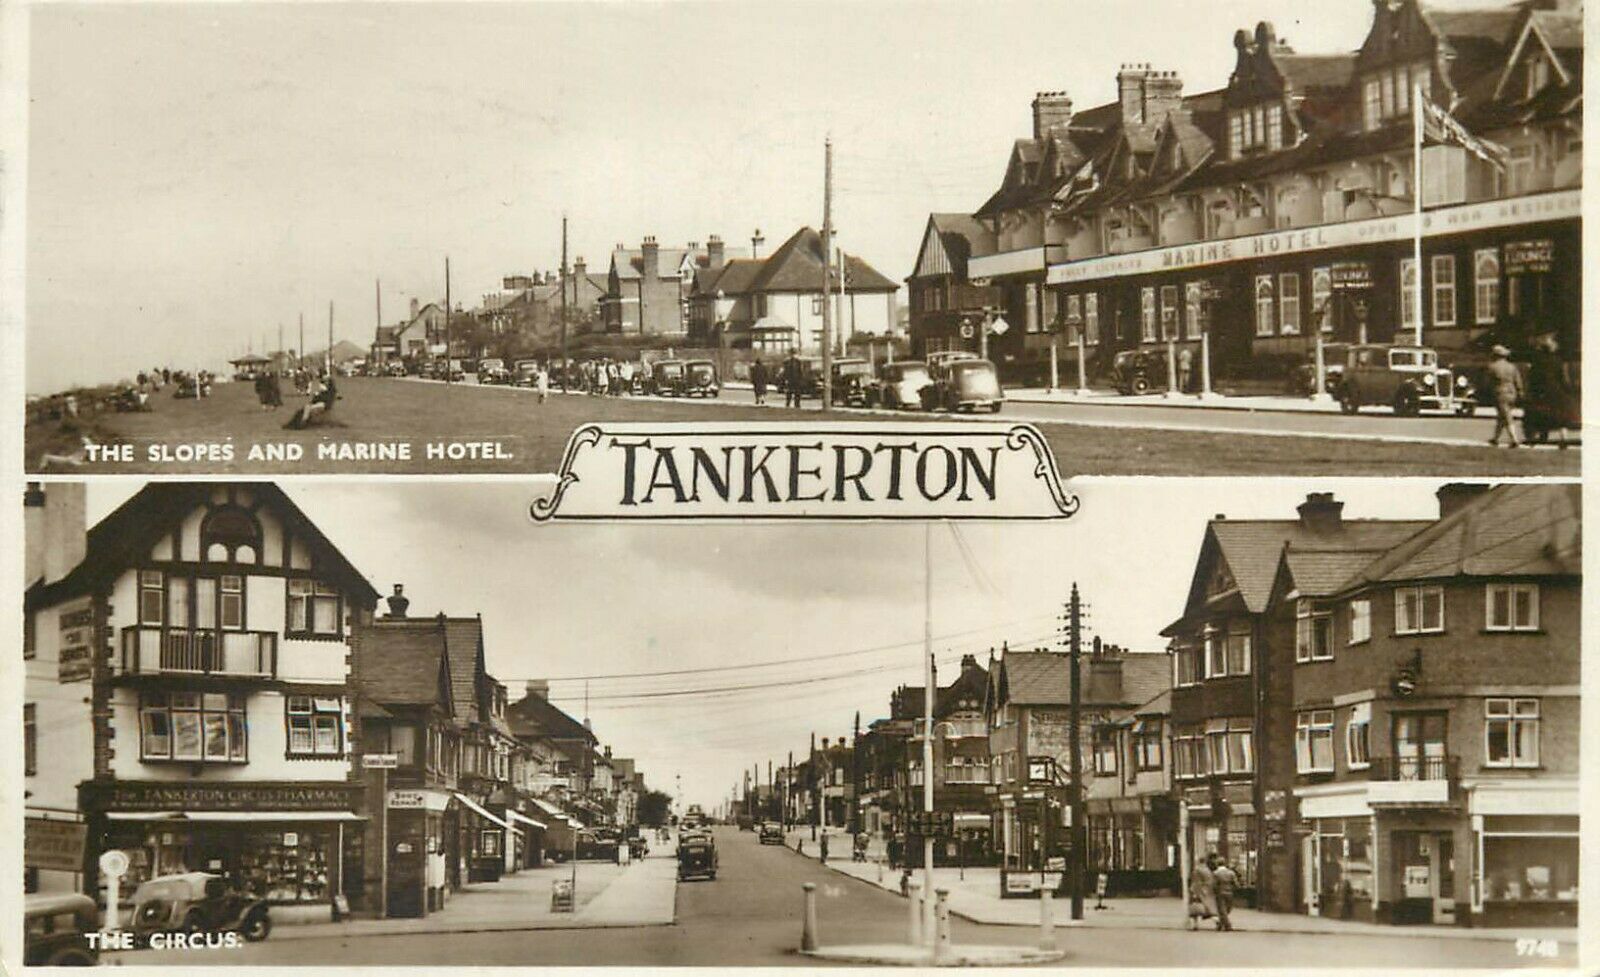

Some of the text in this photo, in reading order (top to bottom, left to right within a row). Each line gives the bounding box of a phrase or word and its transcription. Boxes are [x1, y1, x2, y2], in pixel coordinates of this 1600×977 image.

[1162, 243, 1233, 266] MARINE
[1253, 227, 1328, 254] HOTEL
[144, 789, 224, 801] TANKERTON
